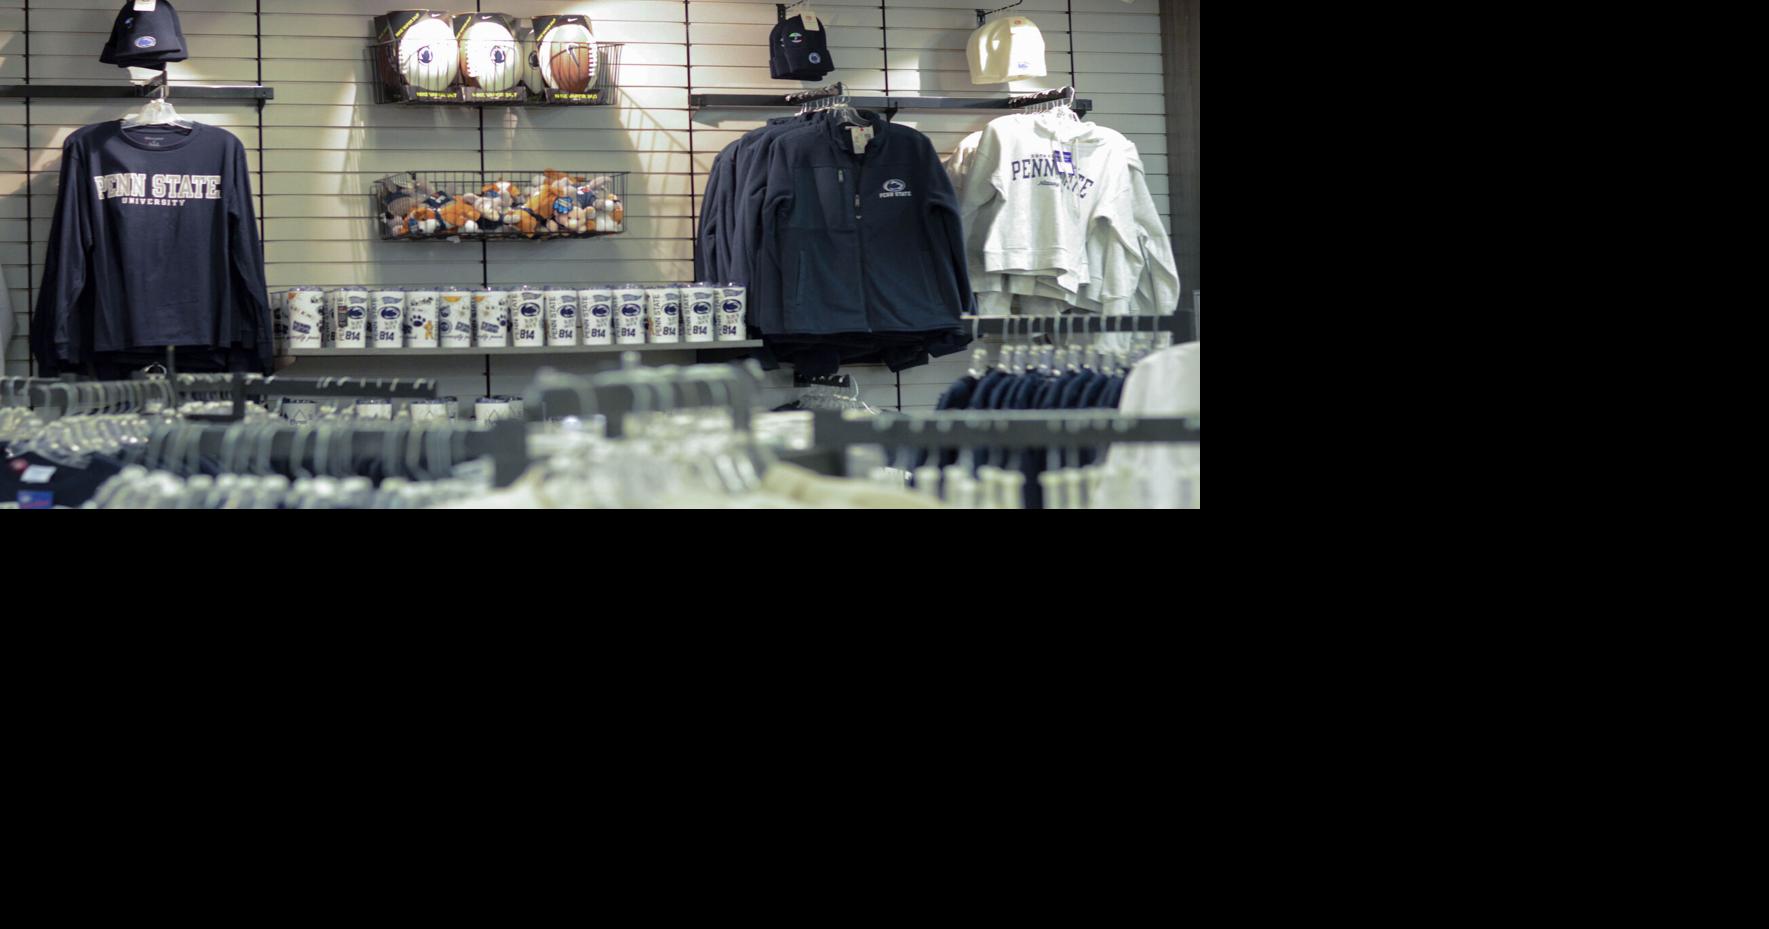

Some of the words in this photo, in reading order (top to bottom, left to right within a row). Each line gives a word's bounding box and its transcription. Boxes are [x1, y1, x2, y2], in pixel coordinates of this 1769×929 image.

[94, 173, 147, 200] PENN
[152, 174, 221, 199] STATE
[121, 198, 187, 206] UNIVERSITY
[520, 330, 535, 340] 814
[559, 329, 573, 339] 814
[592, 328, 606, 338] 814
[621, 328, 636, 337] 814
[663, 326, 677, 336] 814
[693, 325, 707, 335] 814
[722, 325, 736, 335] 814
[380, 331, 394, 341] 814
